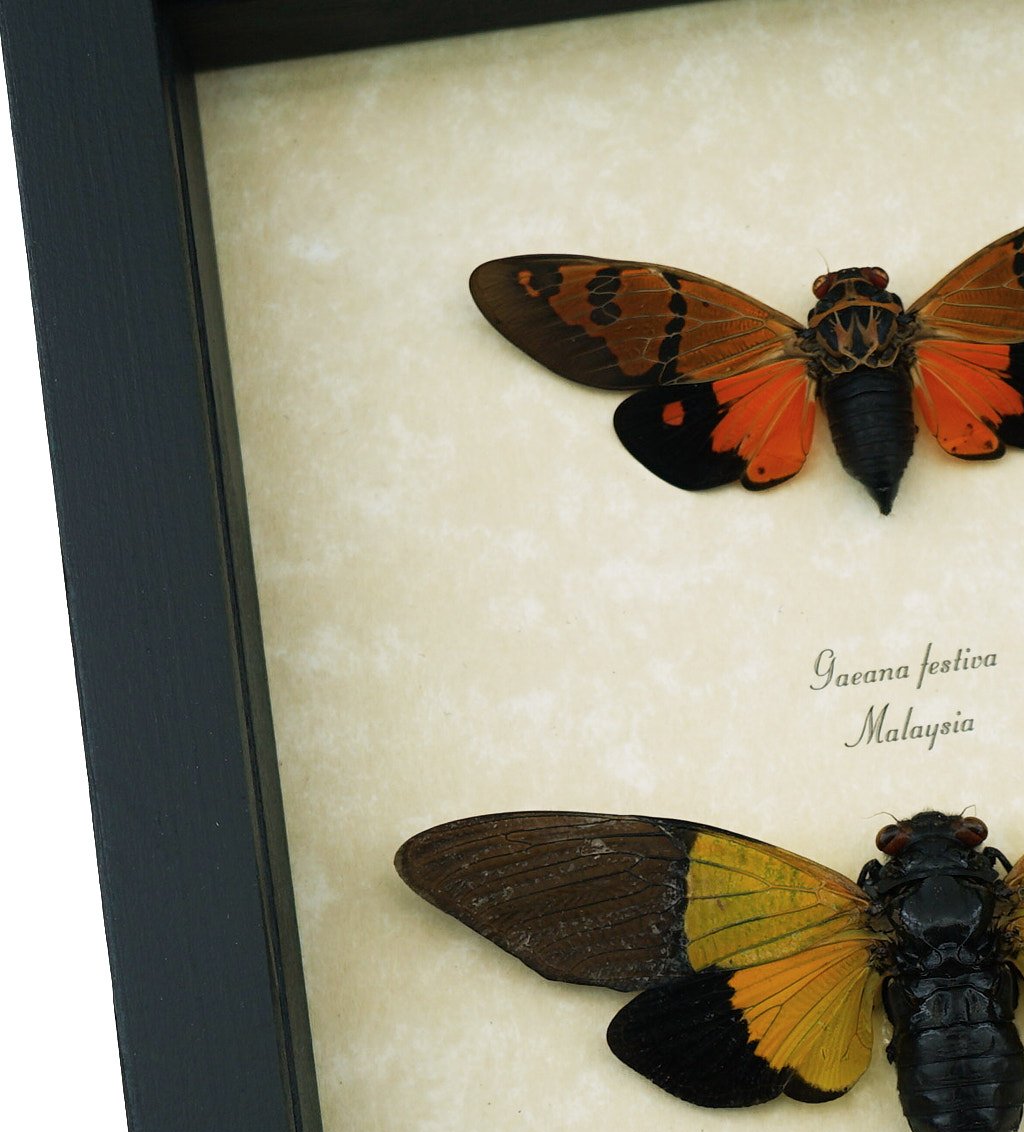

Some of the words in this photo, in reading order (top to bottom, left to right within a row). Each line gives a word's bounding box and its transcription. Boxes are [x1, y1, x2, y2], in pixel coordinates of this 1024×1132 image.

[809, 648, 910, 691] Gaeana
[915, 642, 998, 690] festiva
[844, 702, 975, 751] Malaysia
